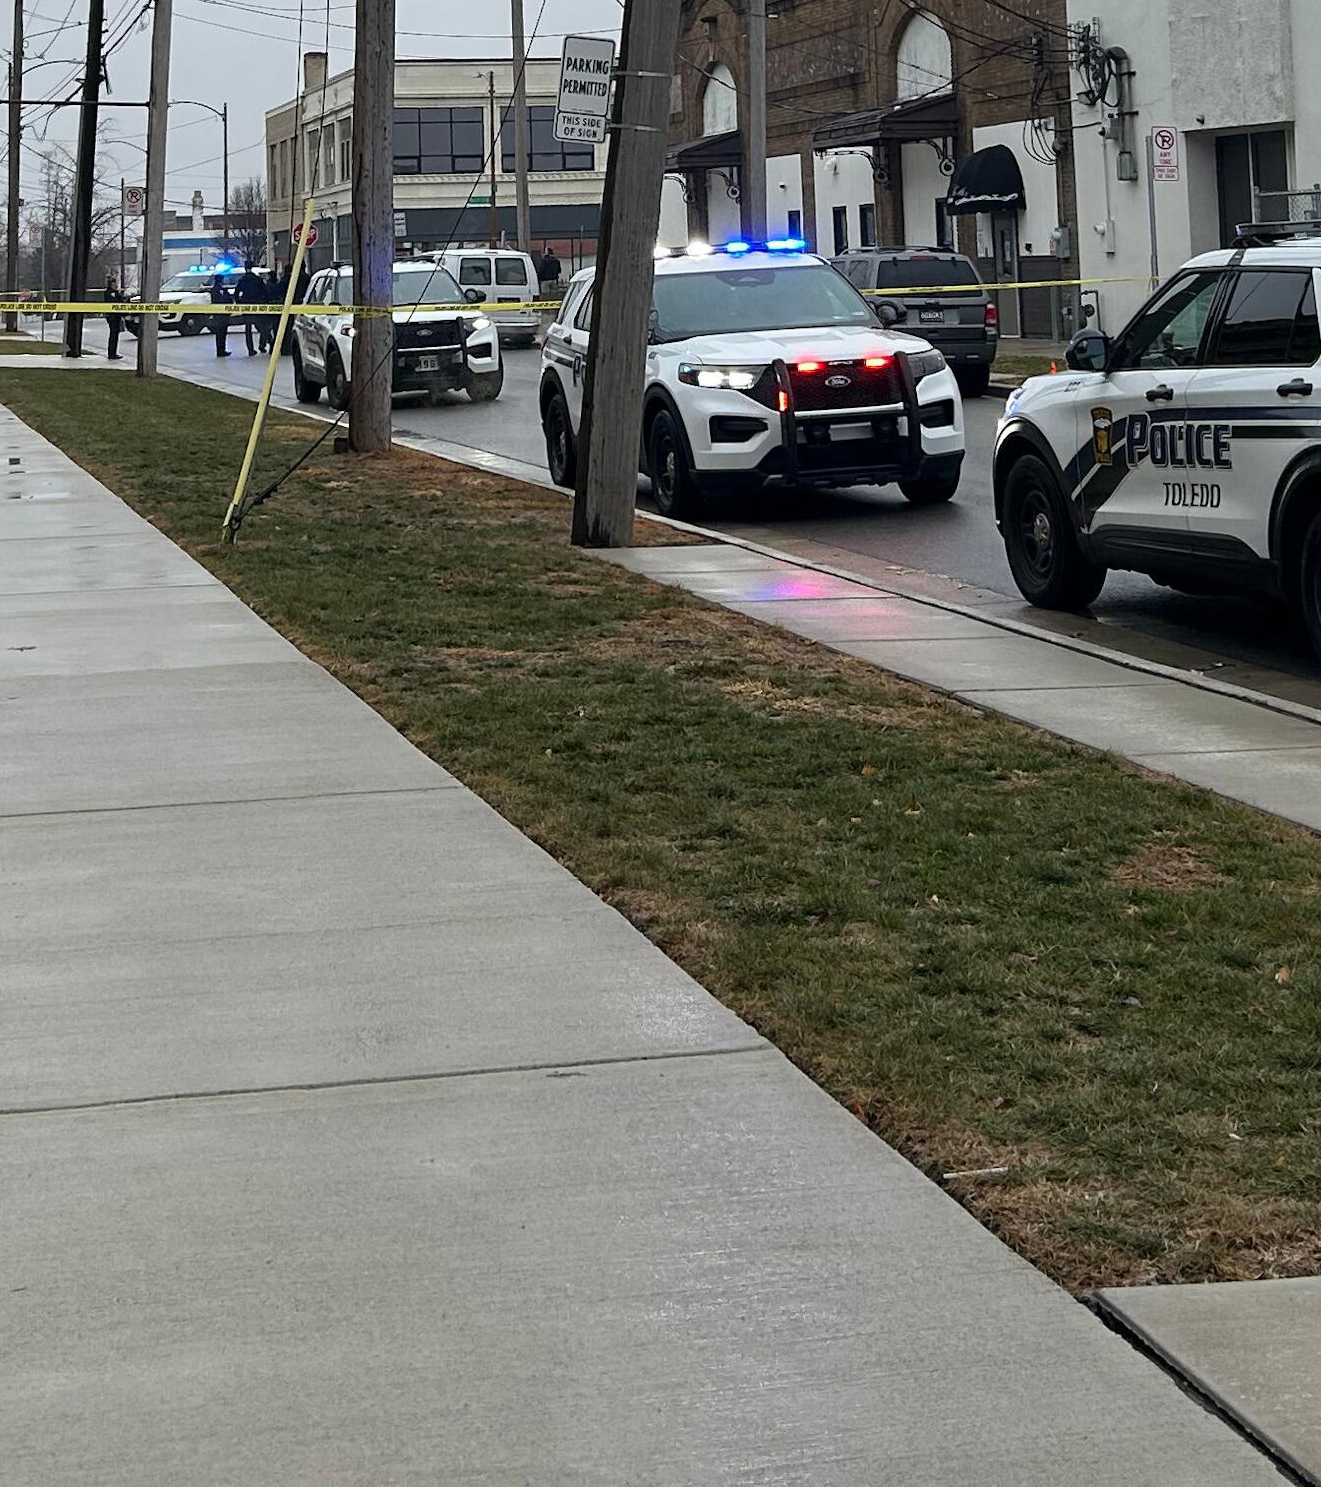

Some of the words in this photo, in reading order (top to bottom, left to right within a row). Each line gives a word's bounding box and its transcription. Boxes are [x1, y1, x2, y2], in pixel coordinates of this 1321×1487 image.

[566, 57, 609, 75] PARKING
[563, 79, 608, 97] PERMITTED
[562, 116, 580, 126] THIS
[582, 118, 602, 128] SIDE
[563, 127, 575, 136] OF
[577, 128, 598, 138] SIGN
[1125, 411, 1233, 470] POLICE
[1163, 482, 1221, 508] TOLEDO
